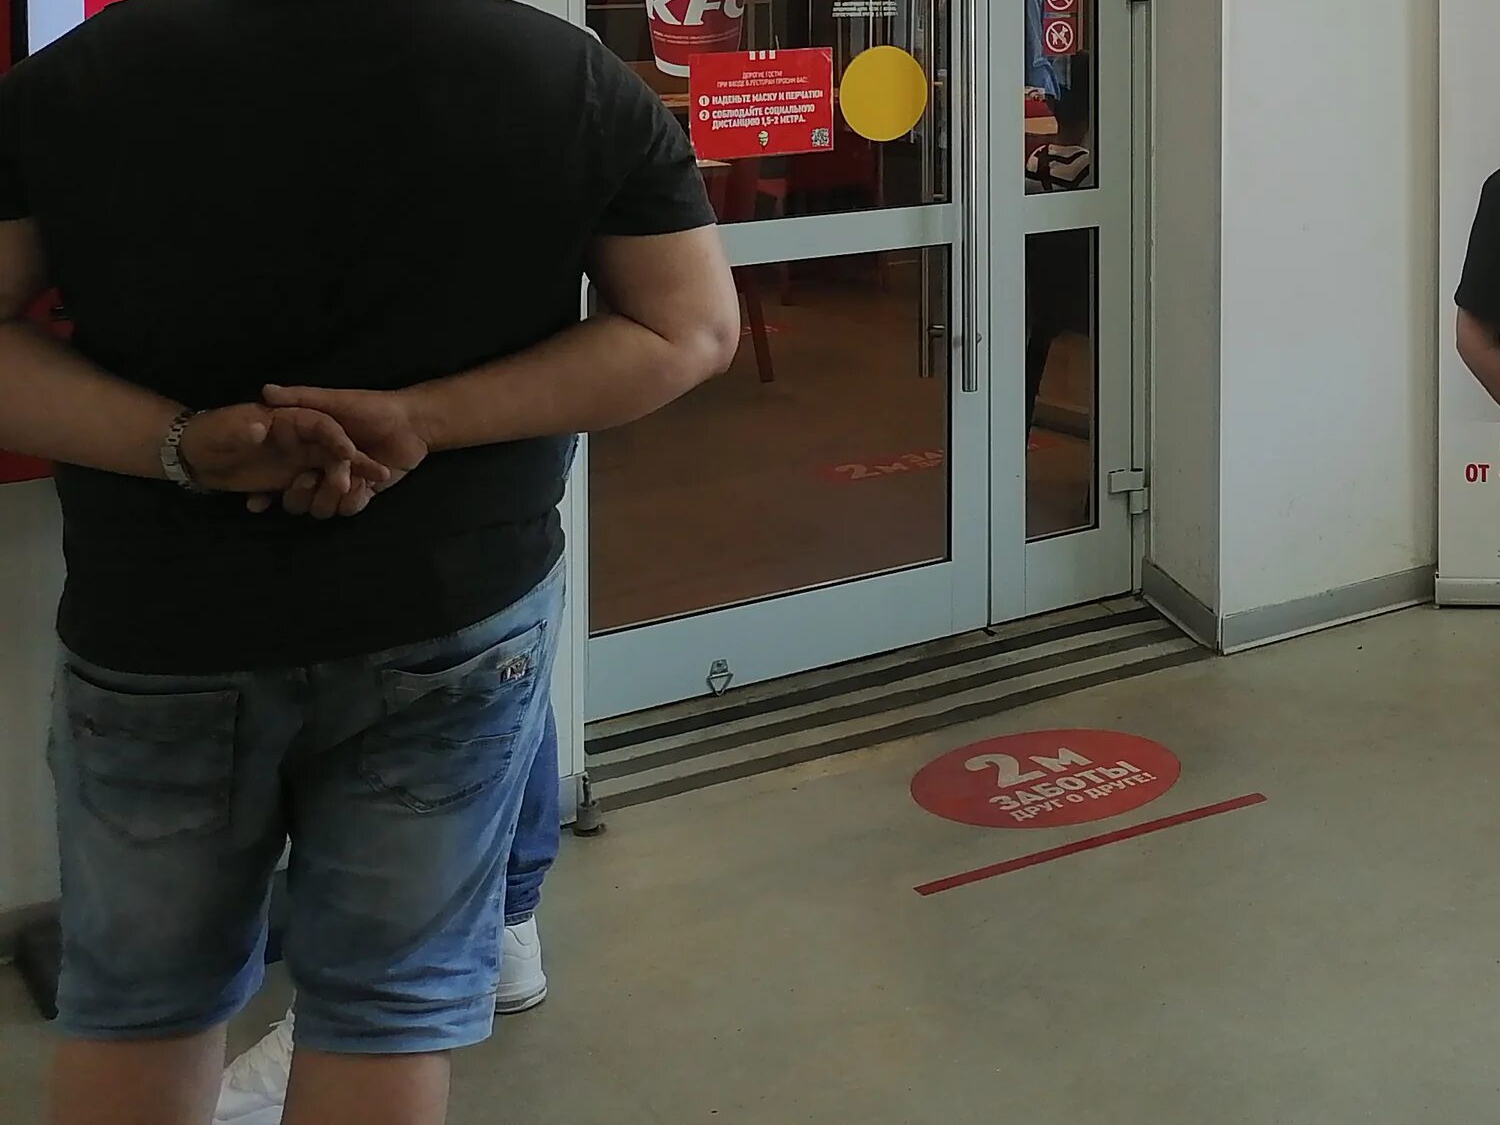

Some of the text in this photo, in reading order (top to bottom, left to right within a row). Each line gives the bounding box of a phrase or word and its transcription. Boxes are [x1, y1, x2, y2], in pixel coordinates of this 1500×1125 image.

[712, 95, 751, 106] НАДЕНЬТЕ
[752, 93, 778, 103] МАСКУ
[779, 92, 785, 101] И
[712, 106, 763, 119] СОБЛЮДАЙТЕ
[765, 104, 815, 115] СОЦИАЛЬНУЮ
[712, 115, 806, 131] ДИСТАНЦИЮ 1,5-2 МЕТРА.
[989, 761, 1142, 810] ЗАБОТЫ
[1010, 773, 1157, 822] ДРУГ О ДРУГЕ!
